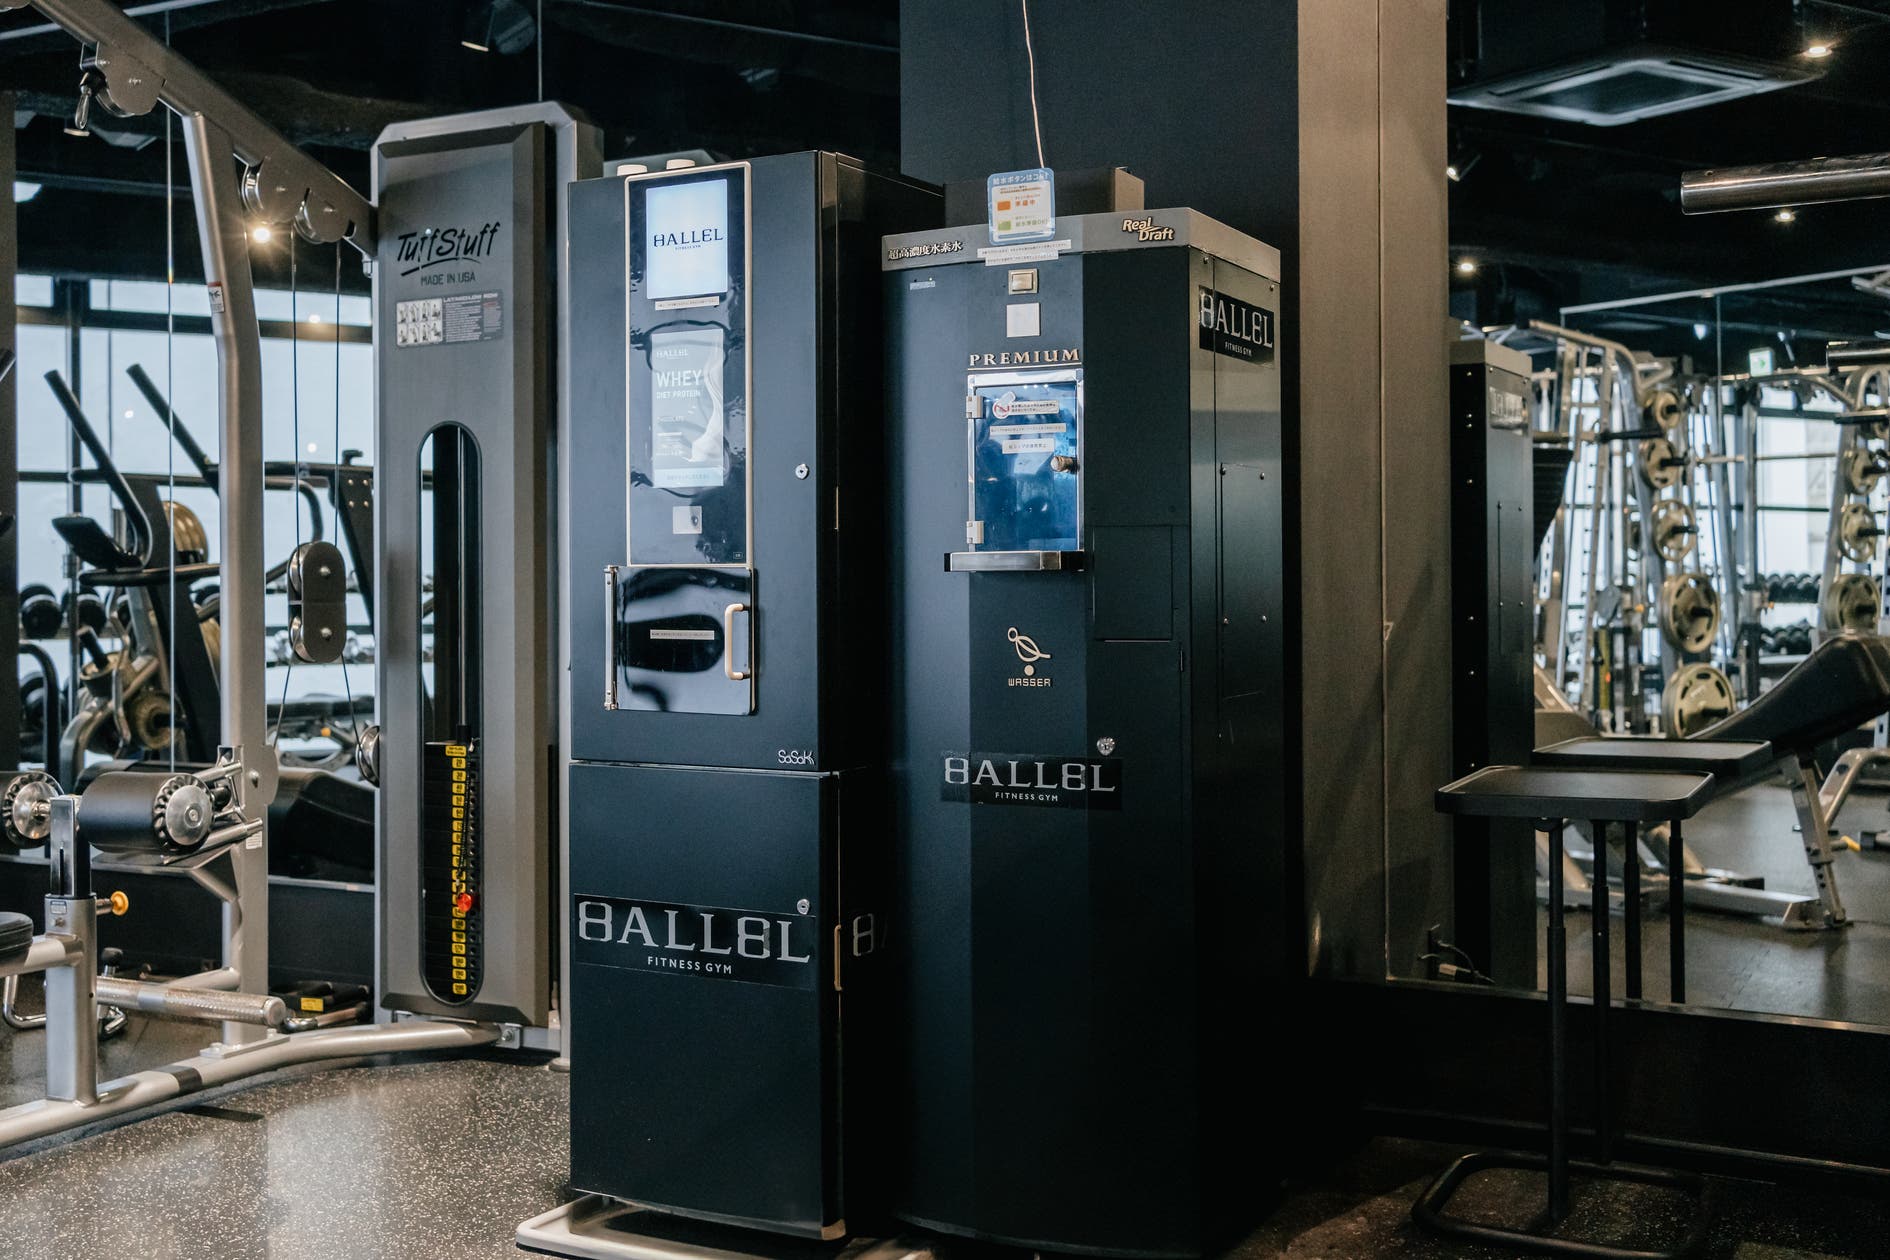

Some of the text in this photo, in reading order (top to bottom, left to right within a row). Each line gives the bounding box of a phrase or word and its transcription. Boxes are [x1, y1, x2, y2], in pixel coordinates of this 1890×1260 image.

[1122, 217, 1152, 232] Real
[398, 222, 500, 262] TuffStuff
[654, 228, 723, 247] HALLEL
[1139, 228, 1174, 241] Draft
[421, 272, 476, 286] MADE IN USA
[970, 349, 1079, 366] PREMIUM
[656, 369, 702, 388] WHEY
[1008, 678, 1051, 687] WASSER
[995, 792, 1035, 800] FITNESS
[648, 956, 732, 974] FITNESS GYM
